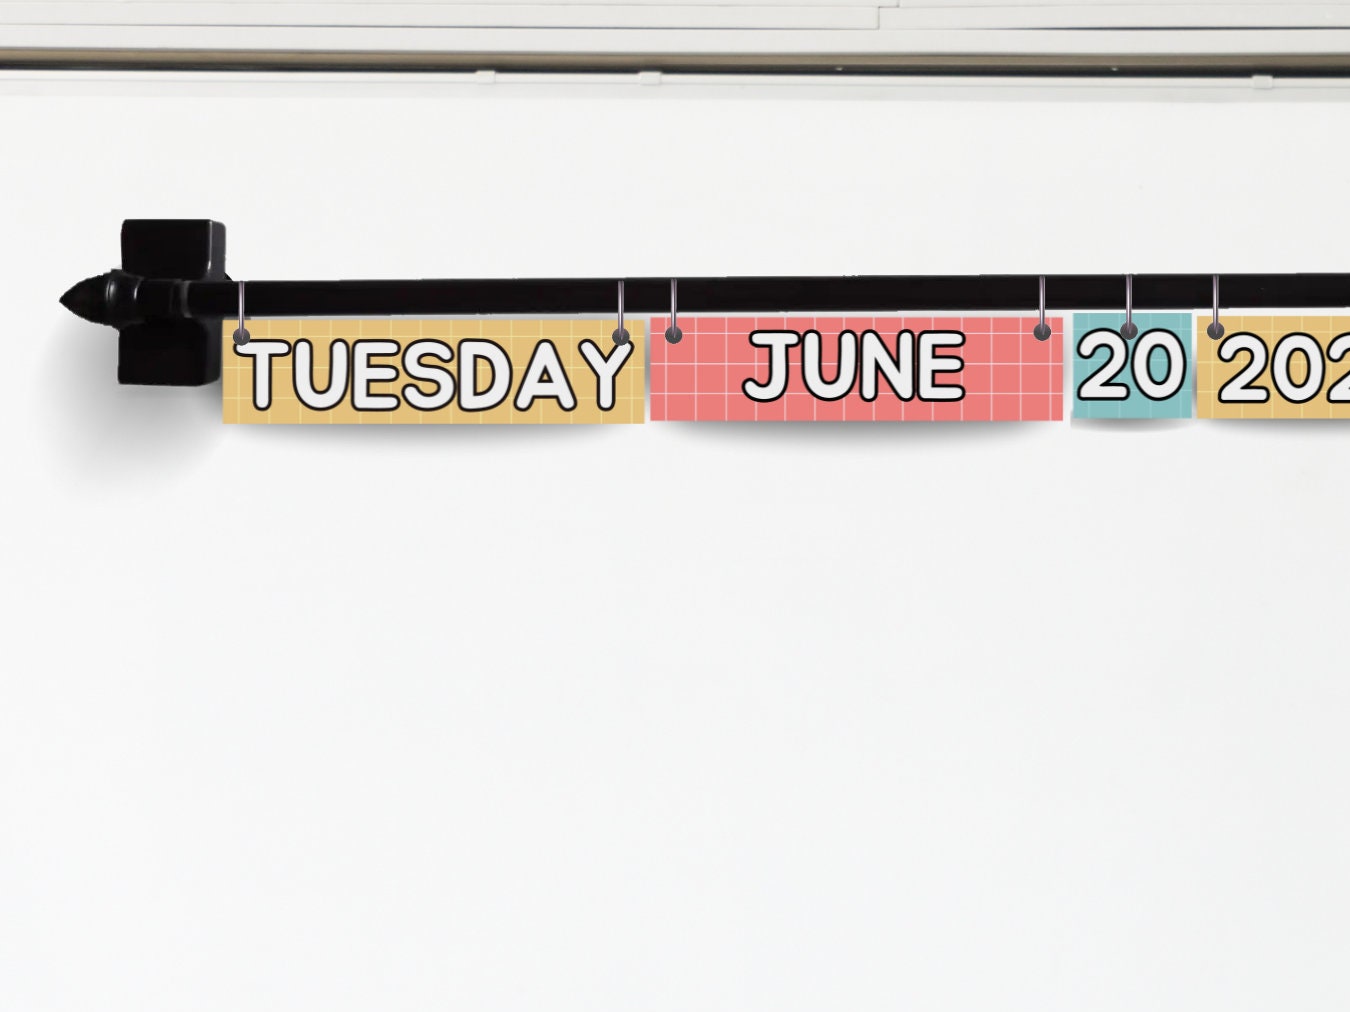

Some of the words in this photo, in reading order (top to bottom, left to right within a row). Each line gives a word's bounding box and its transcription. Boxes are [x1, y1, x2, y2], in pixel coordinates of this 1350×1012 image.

[233, 338, 635, 412] TUESDAY
[742, 329, 966, 403] JUNE
[1077, 328, 1187, 401] 20
